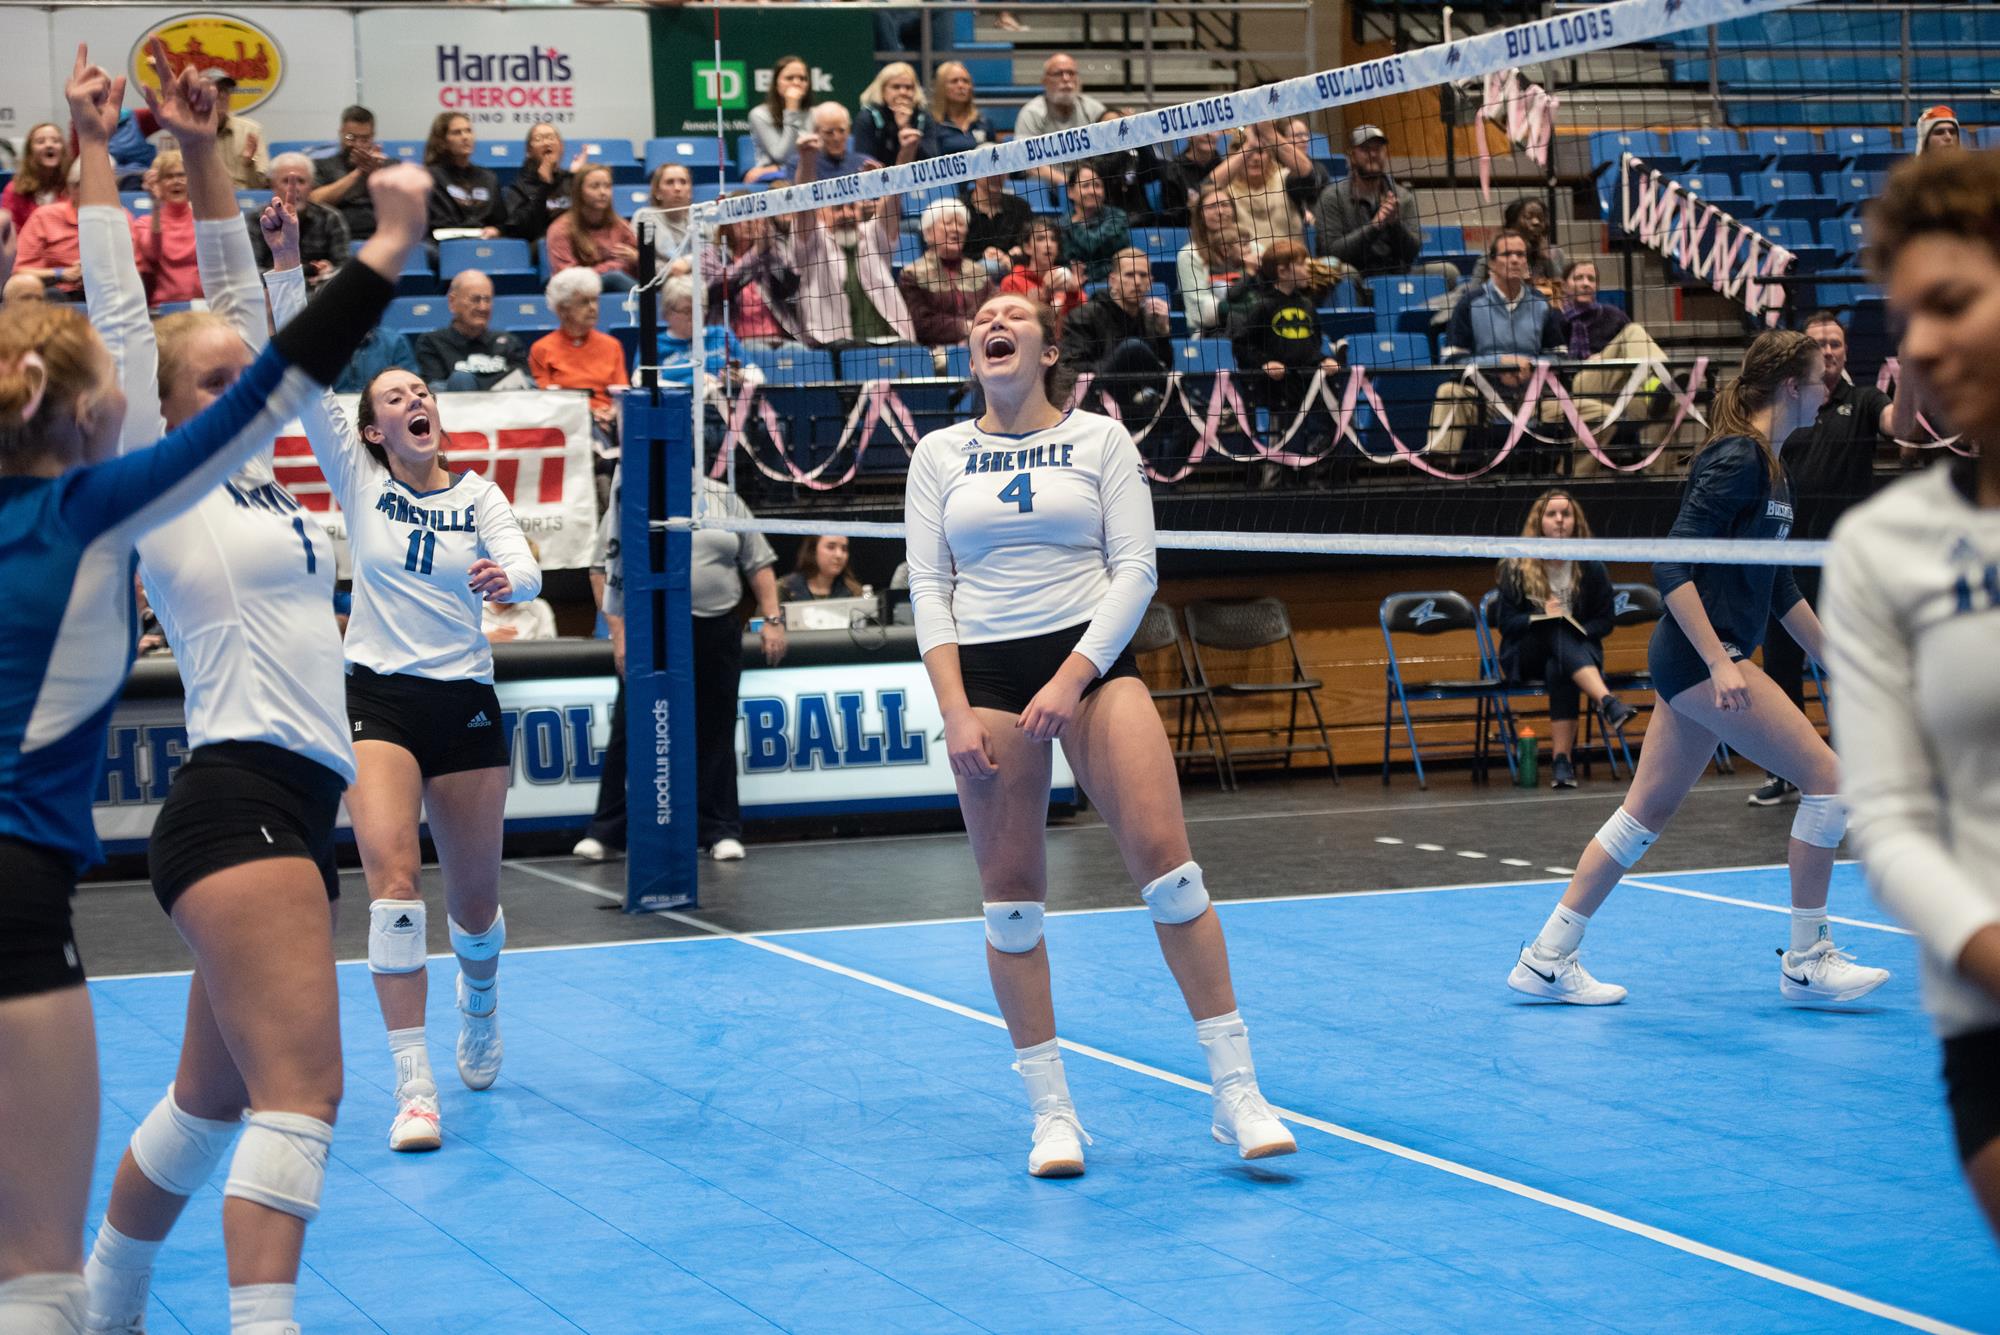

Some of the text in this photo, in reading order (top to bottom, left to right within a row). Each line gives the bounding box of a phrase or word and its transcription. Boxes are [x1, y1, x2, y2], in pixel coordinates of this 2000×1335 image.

[1505, 9, 1613, 59] BULLDOGS
[697, 67, 833, 100] TD Bk
[1316, 58, 1405, 100] BULLDOGS
[438, 87, 573, 108] CHEROKEE
[513, 112, 575, 124] RESORT
[1158, 97, 1234, 134] BULLDOGS
[1026, 128, 1091, 161] BULLDOGS
[964, 444, 1074, 476] ASHEVILLE
[997, 473, 1036, 514] 4
[375, 492, 476, 533] ASHEVILLE
[519, 515, 563, 533] ORTS
[292, 516, 316, 575] 1
[404, 529, 436, 576] 11
[354, 720, 363, 732] 11
[466, 719, 492, 729] adidas
[652, 699, 672, 826] sports imports
